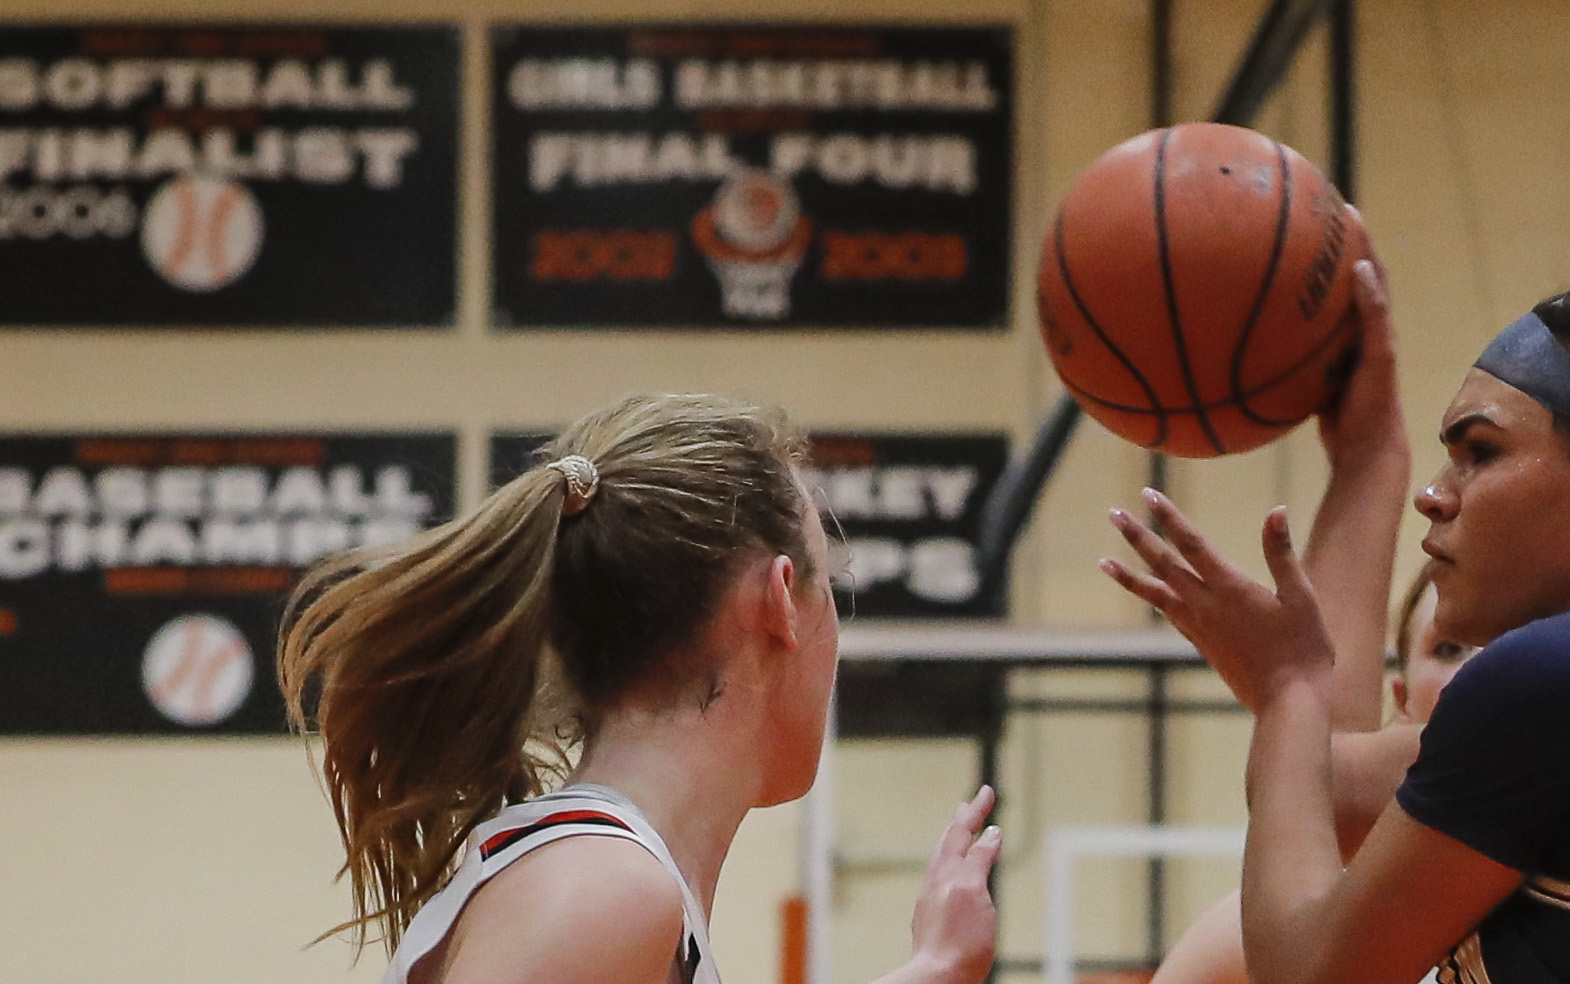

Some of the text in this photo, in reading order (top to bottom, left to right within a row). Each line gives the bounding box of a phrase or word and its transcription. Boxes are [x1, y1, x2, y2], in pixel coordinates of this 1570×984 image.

[0, 57, 415, 111] SOFTBALL
[508, 58, 998, 110] GIRLS BASKETBALL
[0, 127, 418, 190] FINALIST
[530, 133, 978, 195] FINAL FOUR
[0, 465, 432, 514] BASEBALL
